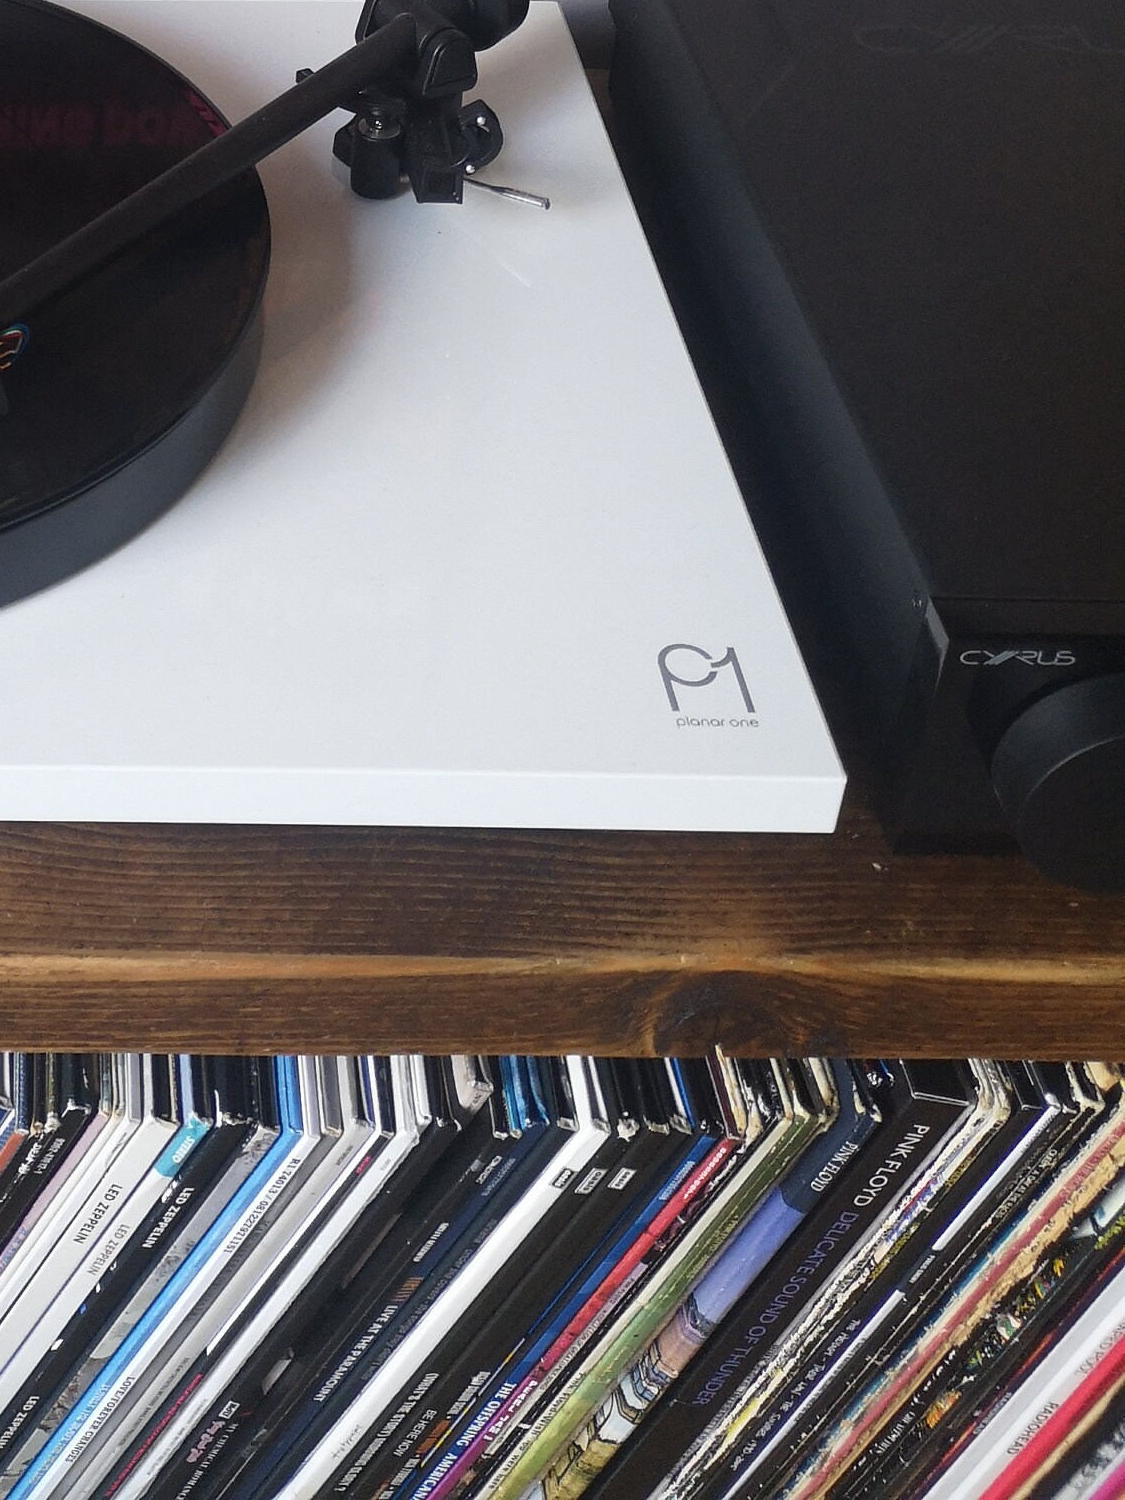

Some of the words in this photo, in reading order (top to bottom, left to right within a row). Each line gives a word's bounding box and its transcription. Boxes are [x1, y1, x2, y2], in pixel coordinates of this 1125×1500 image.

[959, 649, 1076, 666] CYRUS
[676, 716, 726, 729] planar
[729, 716, 760, 729] one
[169, 1134, 195, 1165] STEREO
[830, 1138, 858, 1167] PINK
[890, 1119, 930, 1163] PINK
[266, 1167, 292, 1196] 74013
[553, 1168, 572, 1189] oasis
[581, 1169, 602, 1193] oasis
[612, 1169, 631, 1189] oasis
[808, 1159, 840, 1194] FLOYD
[851, 1157, 898, 1211] FLOYD
[102, 1181, 122, 1203] LED
[172, 1182, 194, 1207] LED
[71, 1199, 110, 1246] ZEPPELIN
[111, 1221, 130, 1241] LED
[140, 1201, 181, 1252] ZEPPELIN
[796, 1207, 858, 1279] DELICATE
[86, 1237, 118, 1277] ZEPPELIN
[756, 1270, 807, 1328] SOUND
[374, 1301, 398, 1326] LIVE
[352, 1331, 373, 1353] THE
[365, 1320, 382, 1338] AT
[740, 1320, 767, 1347] OF
[311, 1347, 360, 1404] PARAMOUNT
[689, 1338, 752, 1411] THUNDER
[20, 1392, 40, 1413] LED
[89, 1373, 135, 1431] LOVE/FOREVER
[494, 1377, 517, 1402] THE
[421, 1406, 437, 1423] BE
[454, 1398, 500, 1450] OFFSPRING
[971, 1390, 1012, 1436] RADIOHEAD
[225, 1421, 238, 1435] MY
[405, 1417, 427, 1442] HERE
[1004, 1398, 1059, 1458] RADIOHEAD
[63, 1428, 94, 1465] CHANGES
[198, 1433, 230, 1471] CHEMICAL
[391, 1437, 412, 1458] NOW
[501, 1451, 520, 1472] were
[486, 1470, 504, 1491] here
